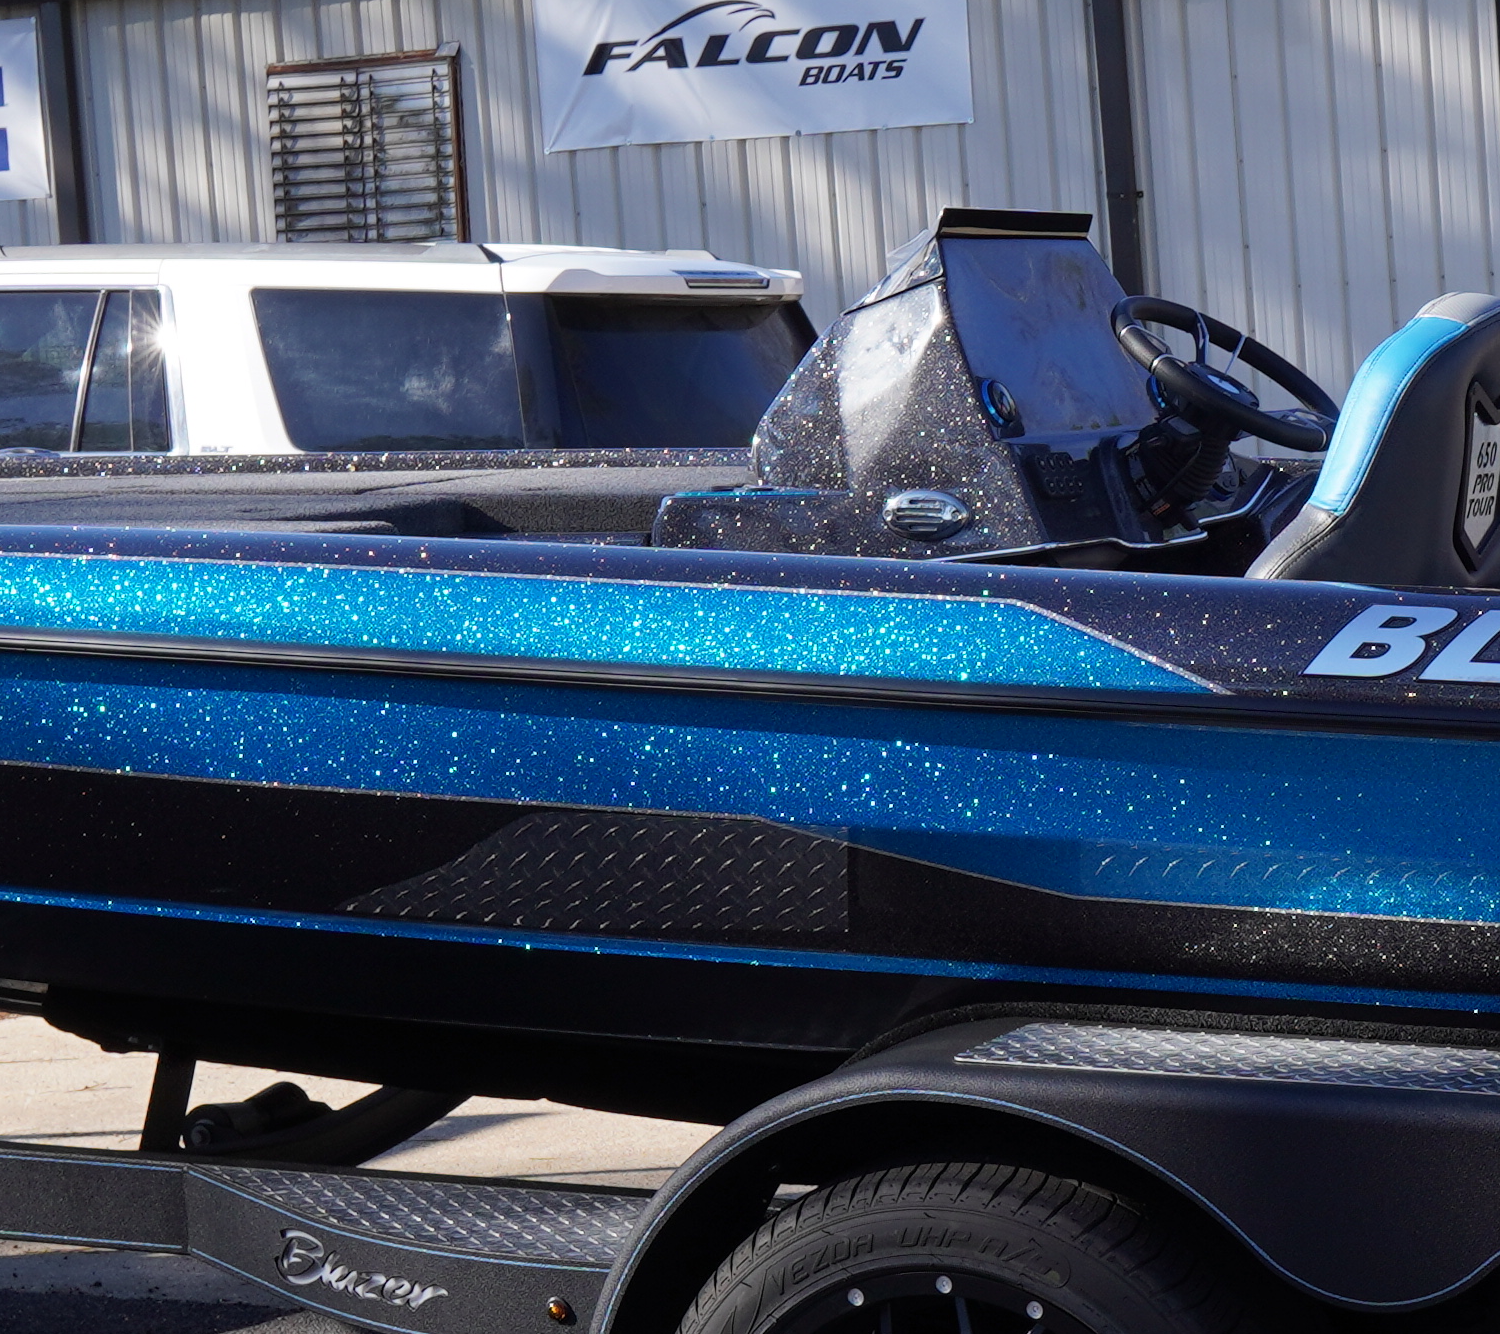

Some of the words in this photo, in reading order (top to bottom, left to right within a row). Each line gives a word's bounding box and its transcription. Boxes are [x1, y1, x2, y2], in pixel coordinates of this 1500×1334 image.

[583, 17, 925, 76] FALCON
[798, 58, 907, 87] BOATS
[1477, 441, 1498, 469] 650
[1472, 473, 1495, 495] PRO
[1466, 495, 1495, 519] TOUR
[274, 1227, 450, 1312] Blazer
[769, 1233, 875, 1295] VEZDA
[898, 1225, 971, 1250] UHP
